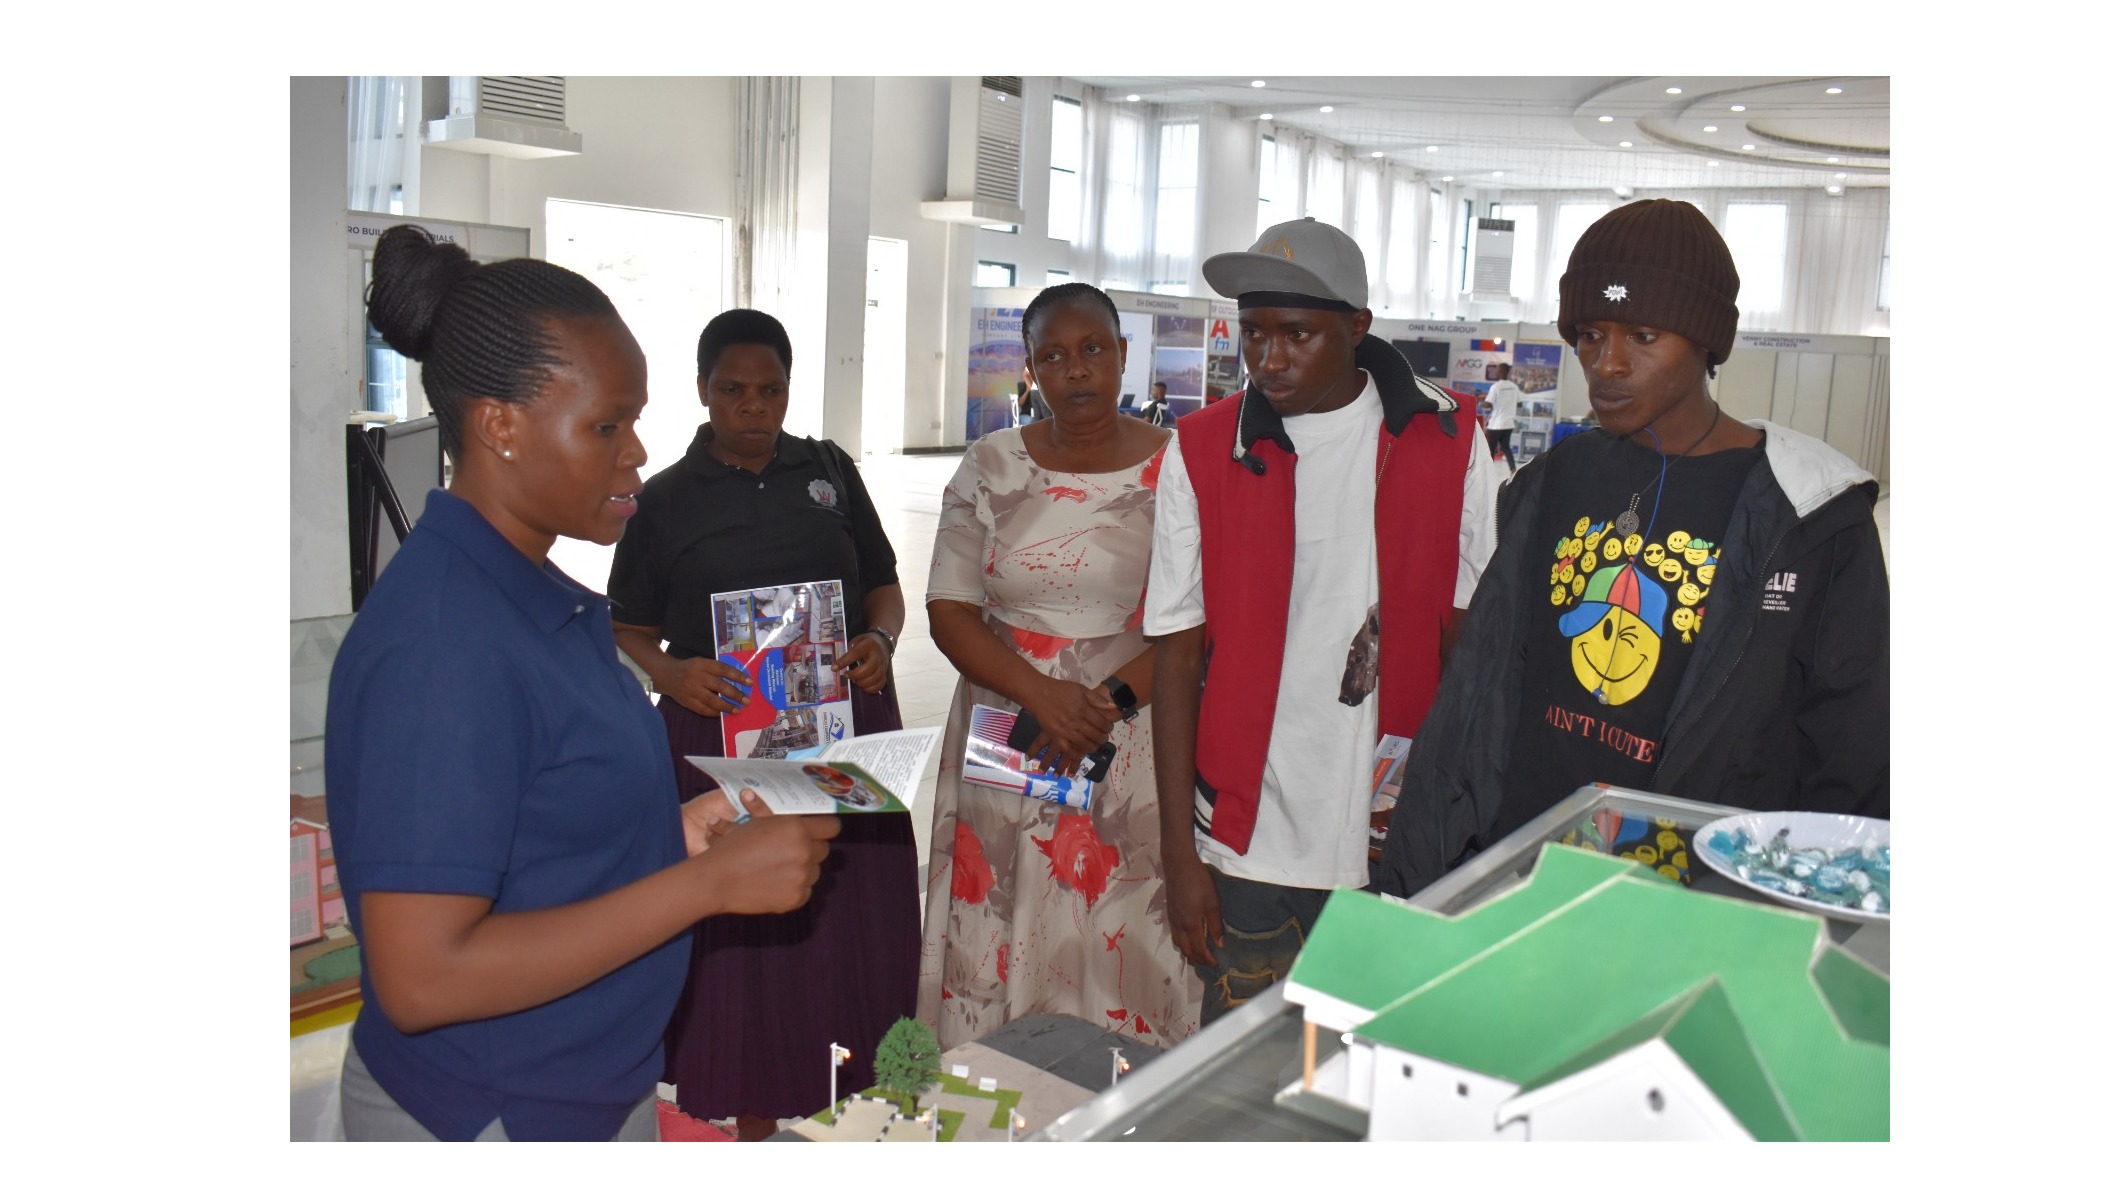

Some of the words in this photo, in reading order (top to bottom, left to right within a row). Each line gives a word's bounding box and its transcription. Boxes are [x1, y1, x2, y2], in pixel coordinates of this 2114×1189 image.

[1145, 300, 1180, 310] ENGINEERING
[1545, 704, 1595, 737] AIN'T
[1599, 721, 1607, 742] I
[1607, 726, 1657, 763] CUTE
